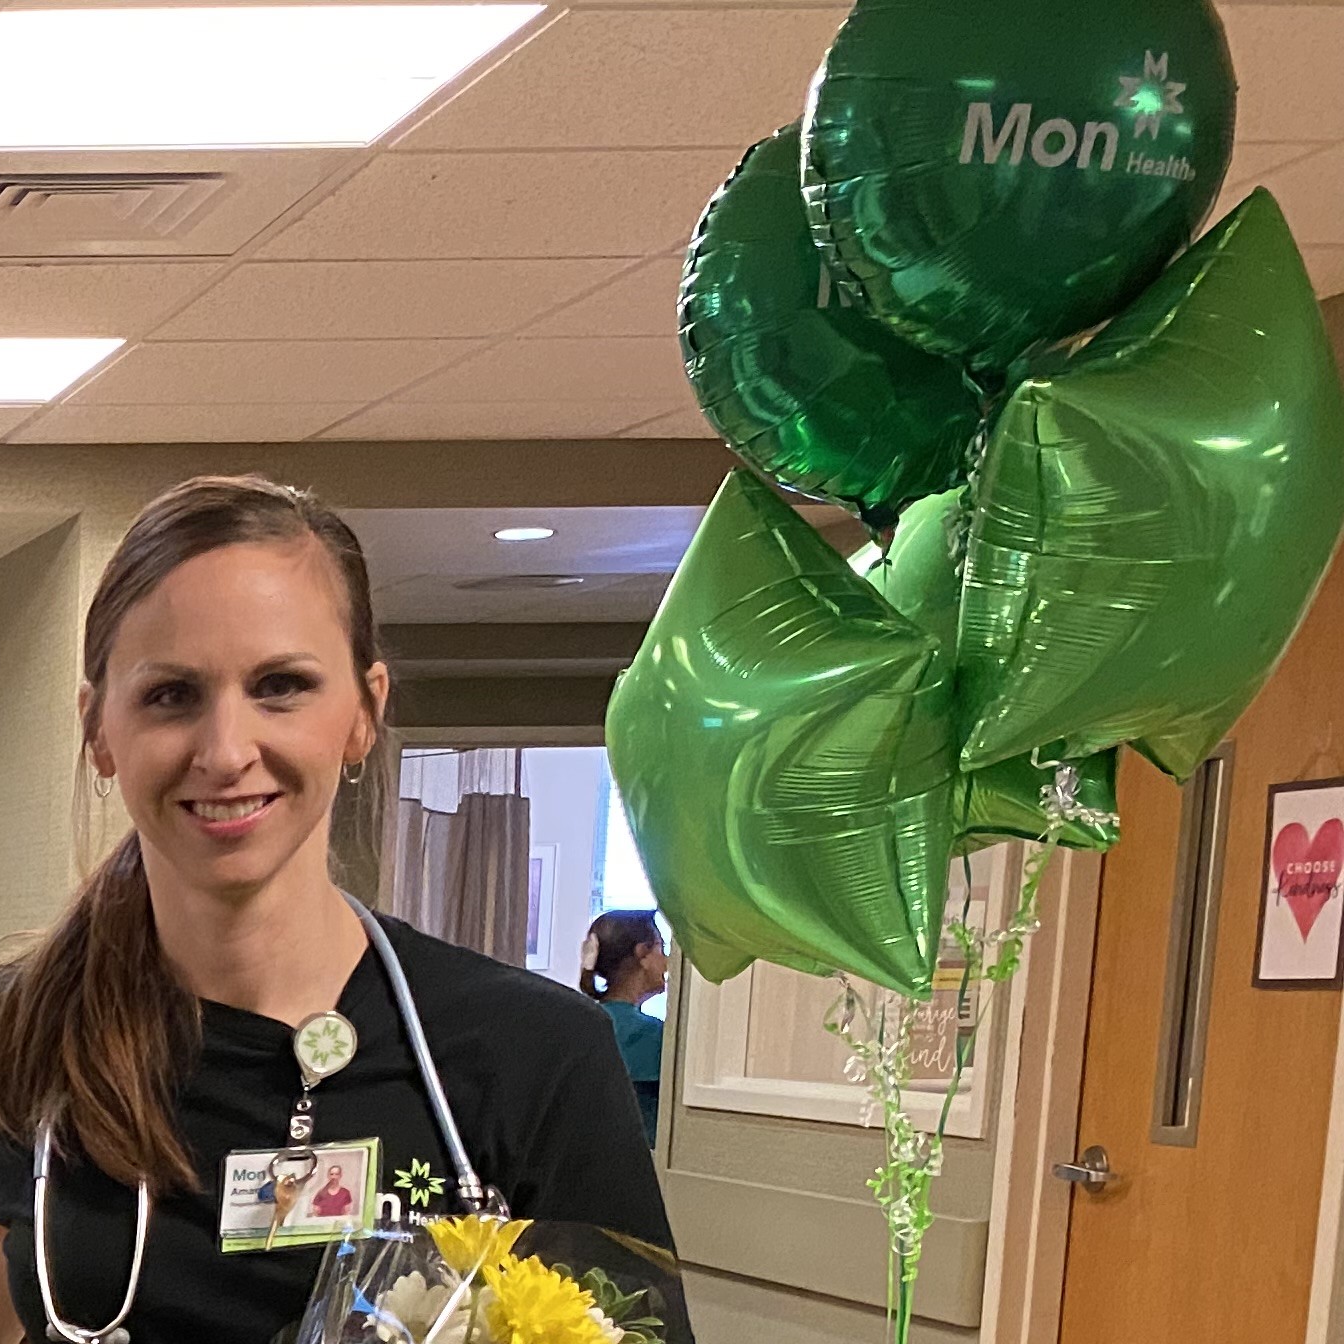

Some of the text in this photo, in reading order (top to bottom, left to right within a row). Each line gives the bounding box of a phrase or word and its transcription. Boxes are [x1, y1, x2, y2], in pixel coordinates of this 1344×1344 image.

[959, 103, 1120, 171] Mon
[1286, 861, 1335, 875] CHOOSE
[233, 1169, 266, 1181] Mon
